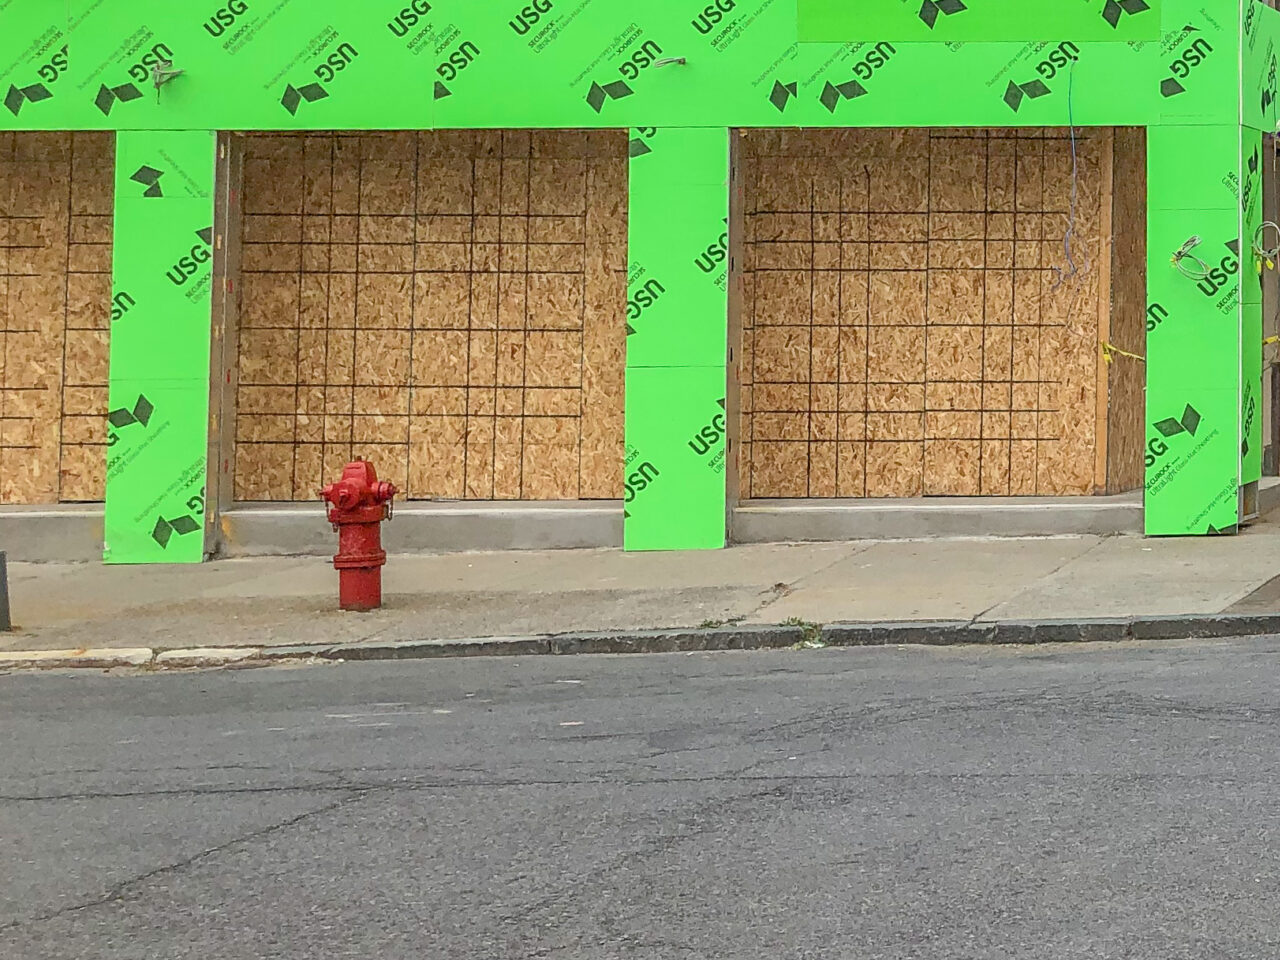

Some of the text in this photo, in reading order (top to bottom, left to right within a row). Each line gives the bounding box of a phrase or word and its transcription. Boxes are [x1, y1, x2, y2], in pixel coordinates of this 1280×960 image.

[314, 42, 359, 83] USG
[436, 41, 481, 81] USG
[618, 40, 663, 80] USG
[851, 41, 896, 80] USG
[1035, 41, 1080, 80] USG
[1169, 38, 1213, 79] USG
[166, 245, 211, 286] USG
[1197, 256, 1238, 297] USG
[1146, 438, 1169, 467] SG
